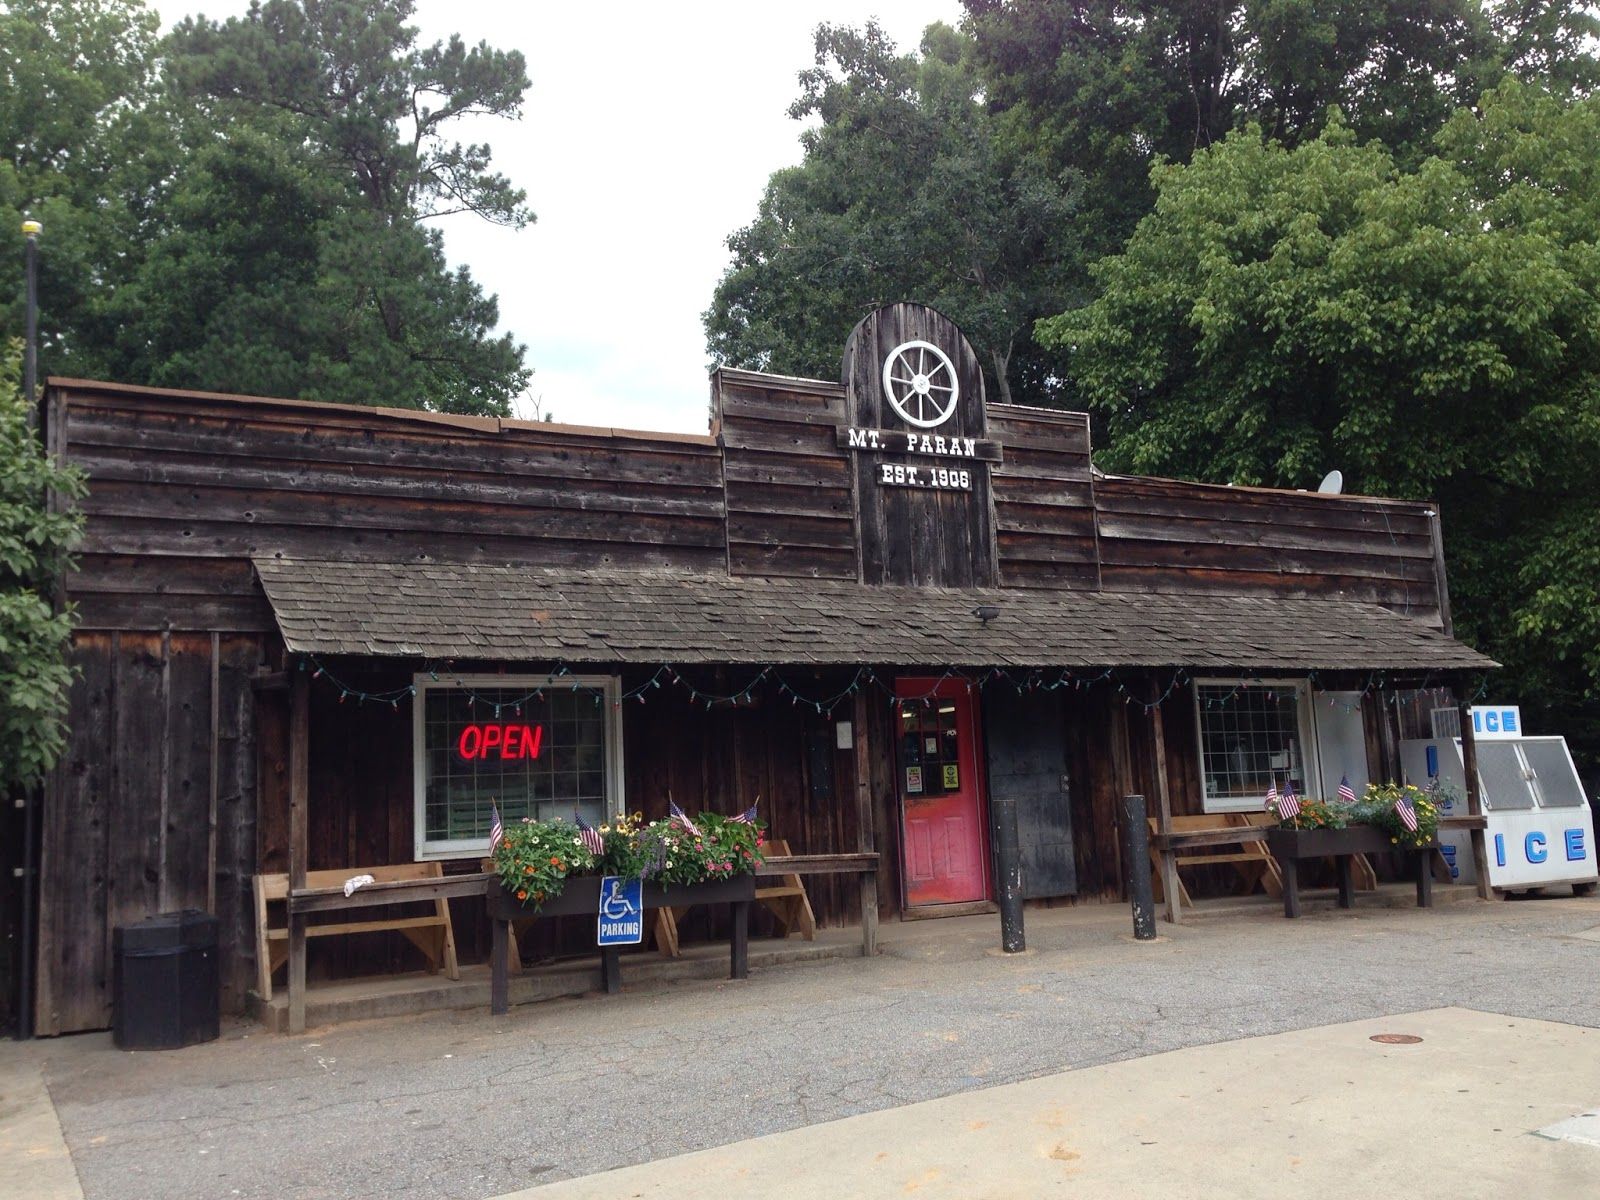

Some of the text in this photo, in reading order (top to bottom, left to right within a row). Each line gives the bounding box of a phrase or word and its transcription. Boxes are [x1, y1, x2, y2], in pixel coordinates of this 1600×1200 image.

[849, 428, 976, 457] MT. PARAN
[882, 464, 969, 489] EST. 1906
[1473, 711, 1517, 732] ICE
[459, 724, 542, 760] OPEN
[1494, 828, 1586, 867] ICE
[601, 922, 639, 937] PARKING
